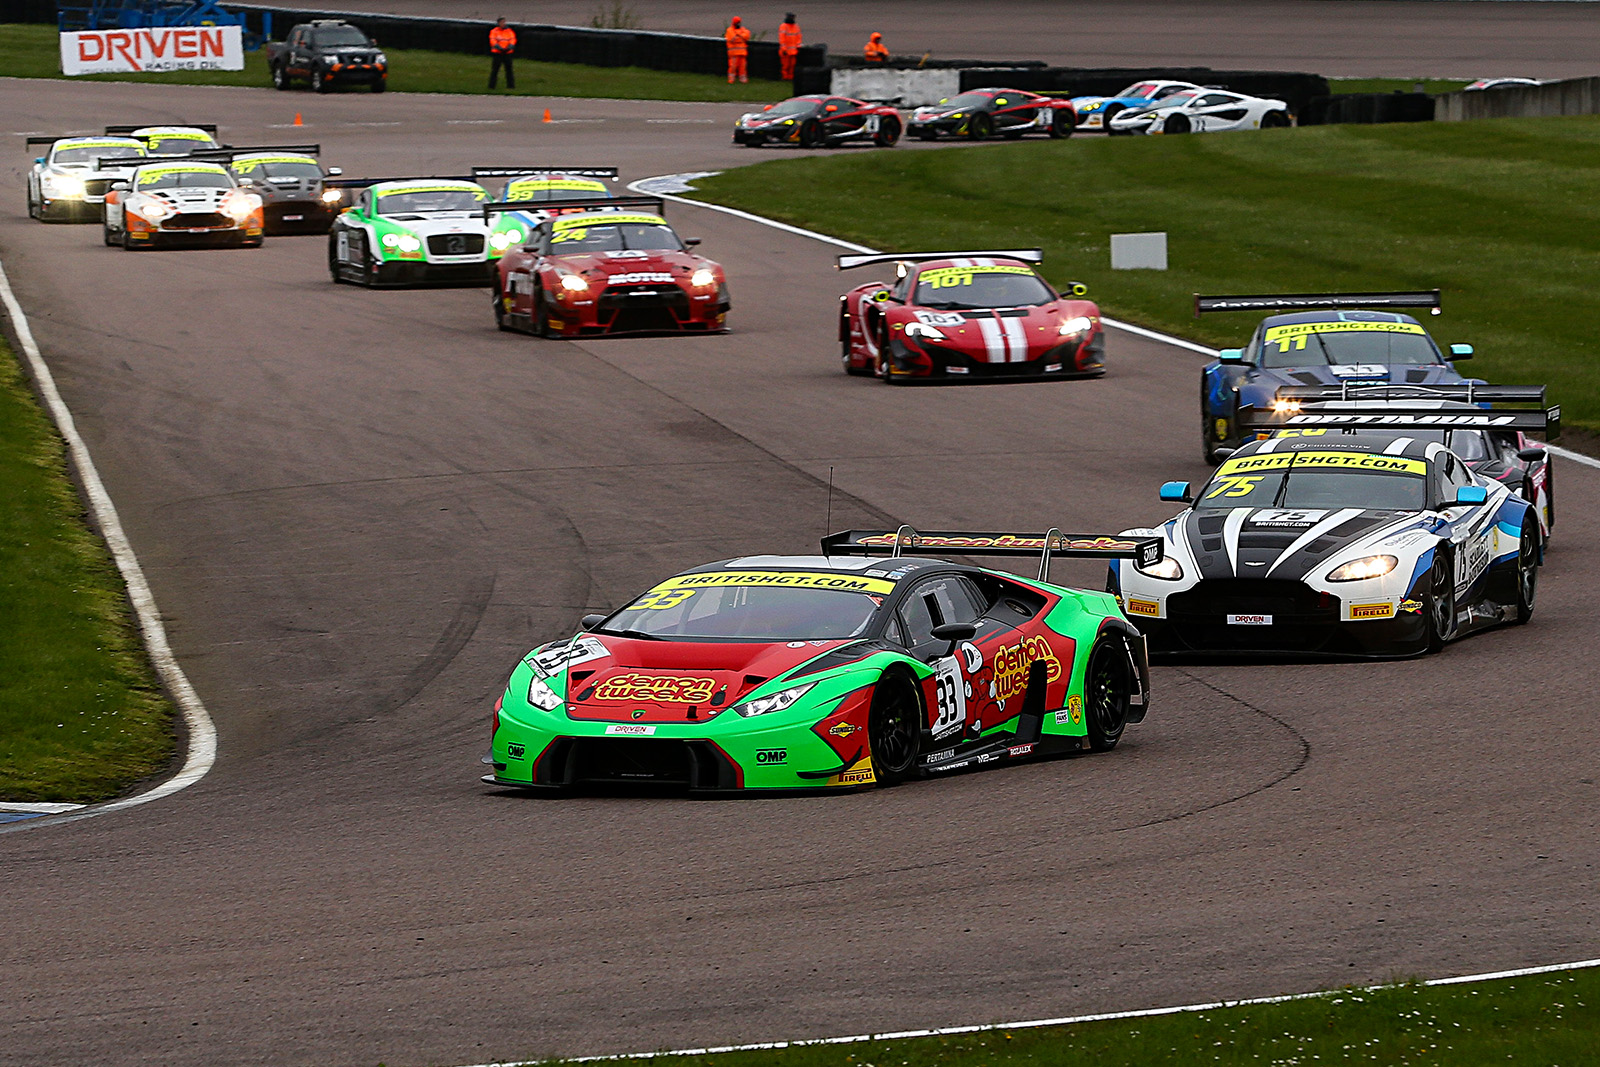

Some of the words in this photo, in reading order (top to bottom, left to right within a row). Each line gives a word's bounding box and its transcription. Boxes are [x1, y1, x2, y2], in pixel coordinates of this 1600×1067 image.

[78, 30, 224, 71] DRIVEN
[145, 61, 195, 70] RACING
[506, 191, 534, 202] 99
[551, 228, 588, 243] 24
[607, 272, 676, 285] MOTUL
[931, 273, 973, 290] 101
[920, 314, 960, 323] 101
[1278, 323, 1411, 335] BRITISHGT.COM
[1274, 334, 1308, 353] 11
[1285, 414, 1517, 426] OPTIMUM
[1235, 455, 1408, 471] BRITISHGT.COM
[1205, 476, 1265, 500] 75
[1269, 511, 1310, 520] 75
[1143, 547, 1159, 562] OMP
[678, 573, 870, 591] BRITISHGT.COM
[625, 589, 697, 611] 33
[1129, 600, 1157, 614] PIRELLI
[1352, 605, 1390, 617] PIRELLI
[1235, 615, 1265, 624] DRIVEN
[994, 633, 1055, 676] demon
[606, 672, 717, 691] demon
[594, 684, 714, 703] tweeks
[614, 725, 647, 734] DRIVEN
[508, 745, 525, 758] OMP
[756, 751, 787, 763] OMP
